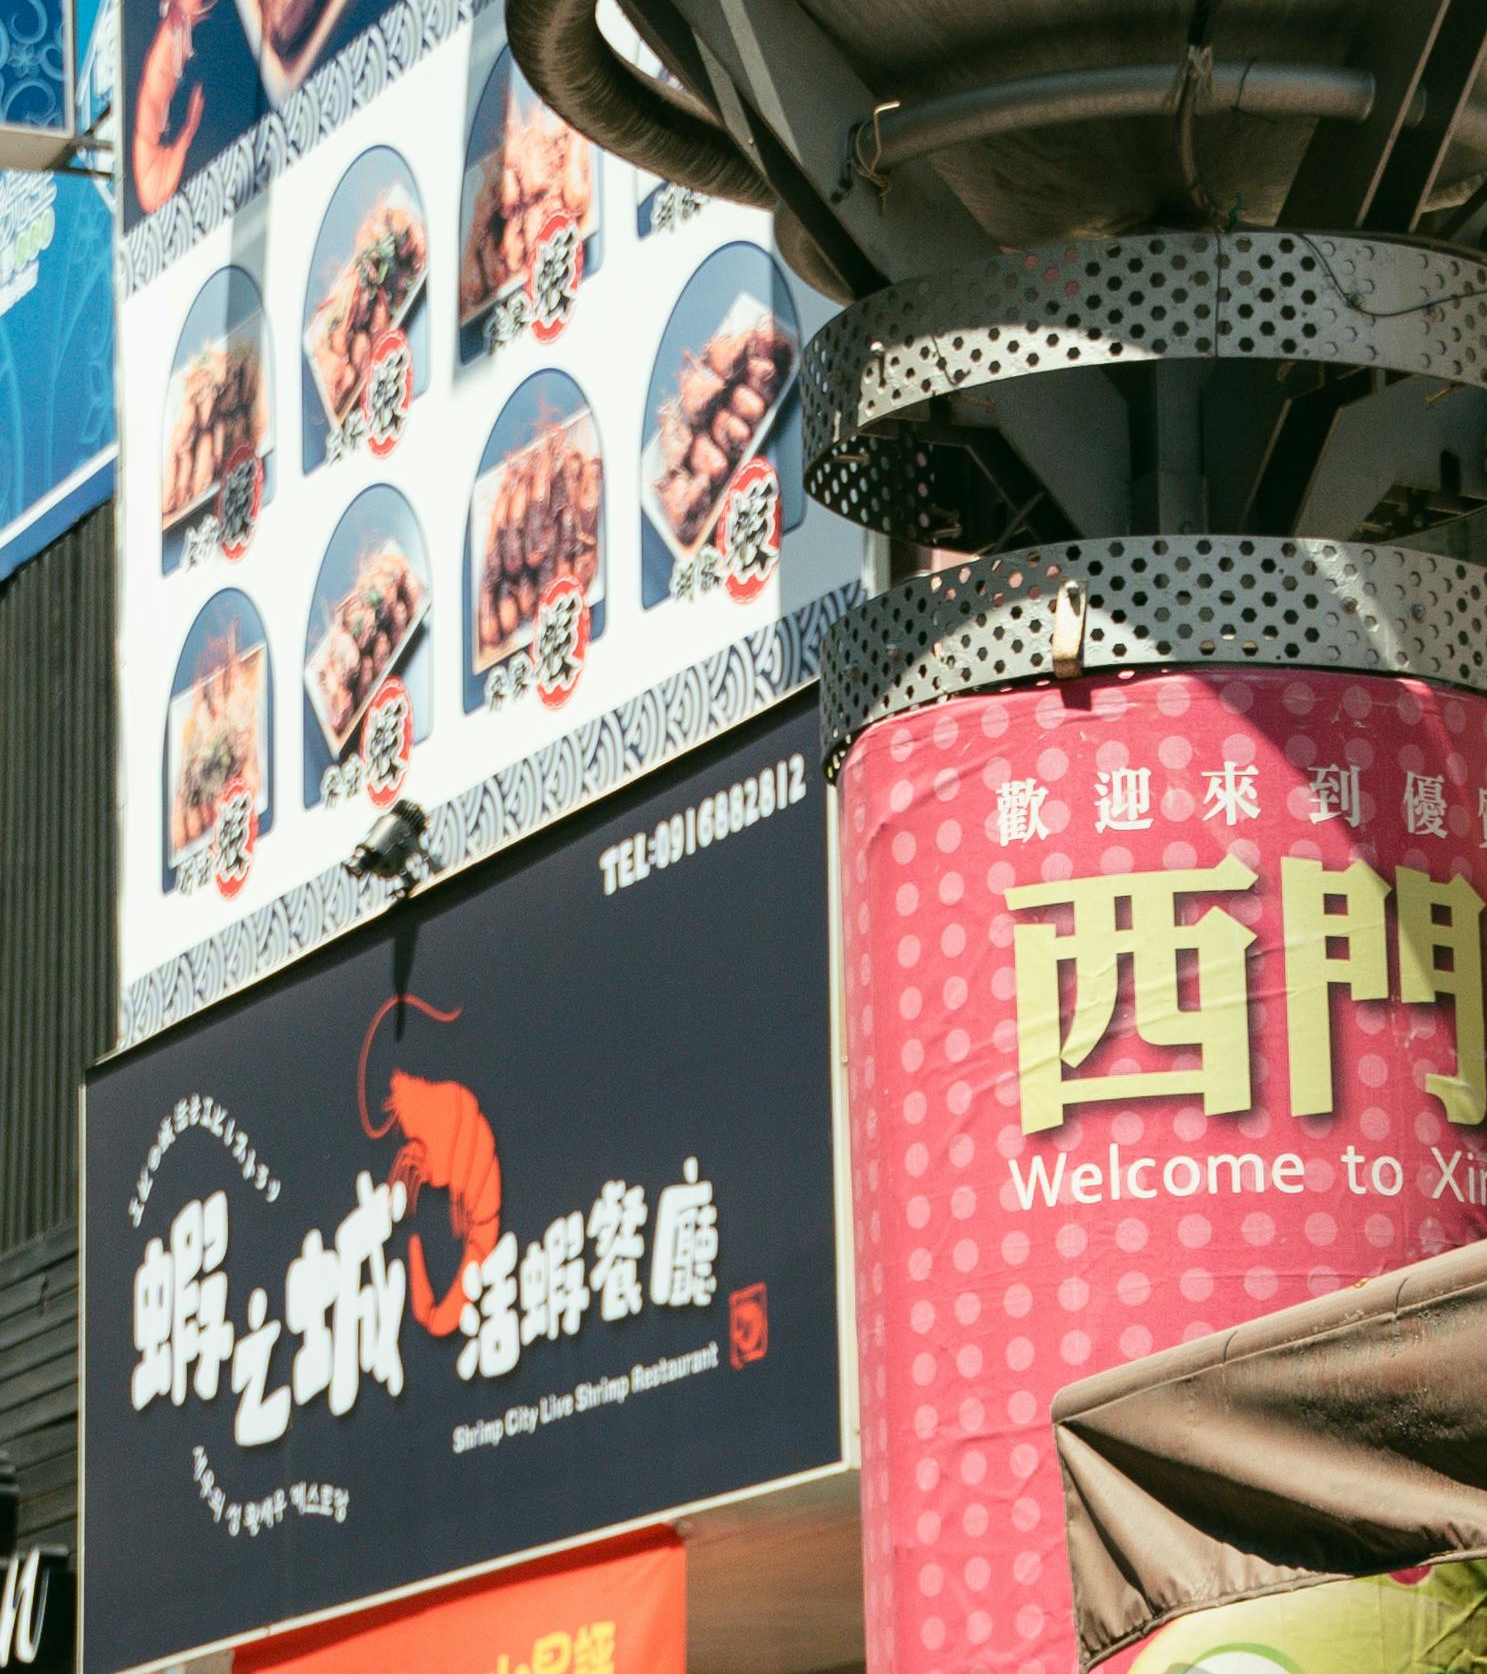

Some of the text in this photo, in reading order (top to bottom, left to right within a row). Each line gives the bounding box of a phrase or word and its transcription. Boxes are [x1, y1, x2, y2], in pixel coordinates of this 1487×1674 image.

[599, 752, 808, 896] TEL:0916882812
[1009, 1142, 1306, 1211] Welcome
[1341, 1142, 1405, 1197] to
[456, 1155, 719, 1381] 活蝦餐廳
[452, 1340, 719, 1454] Shrimp City Live Shrimp Restaurant
